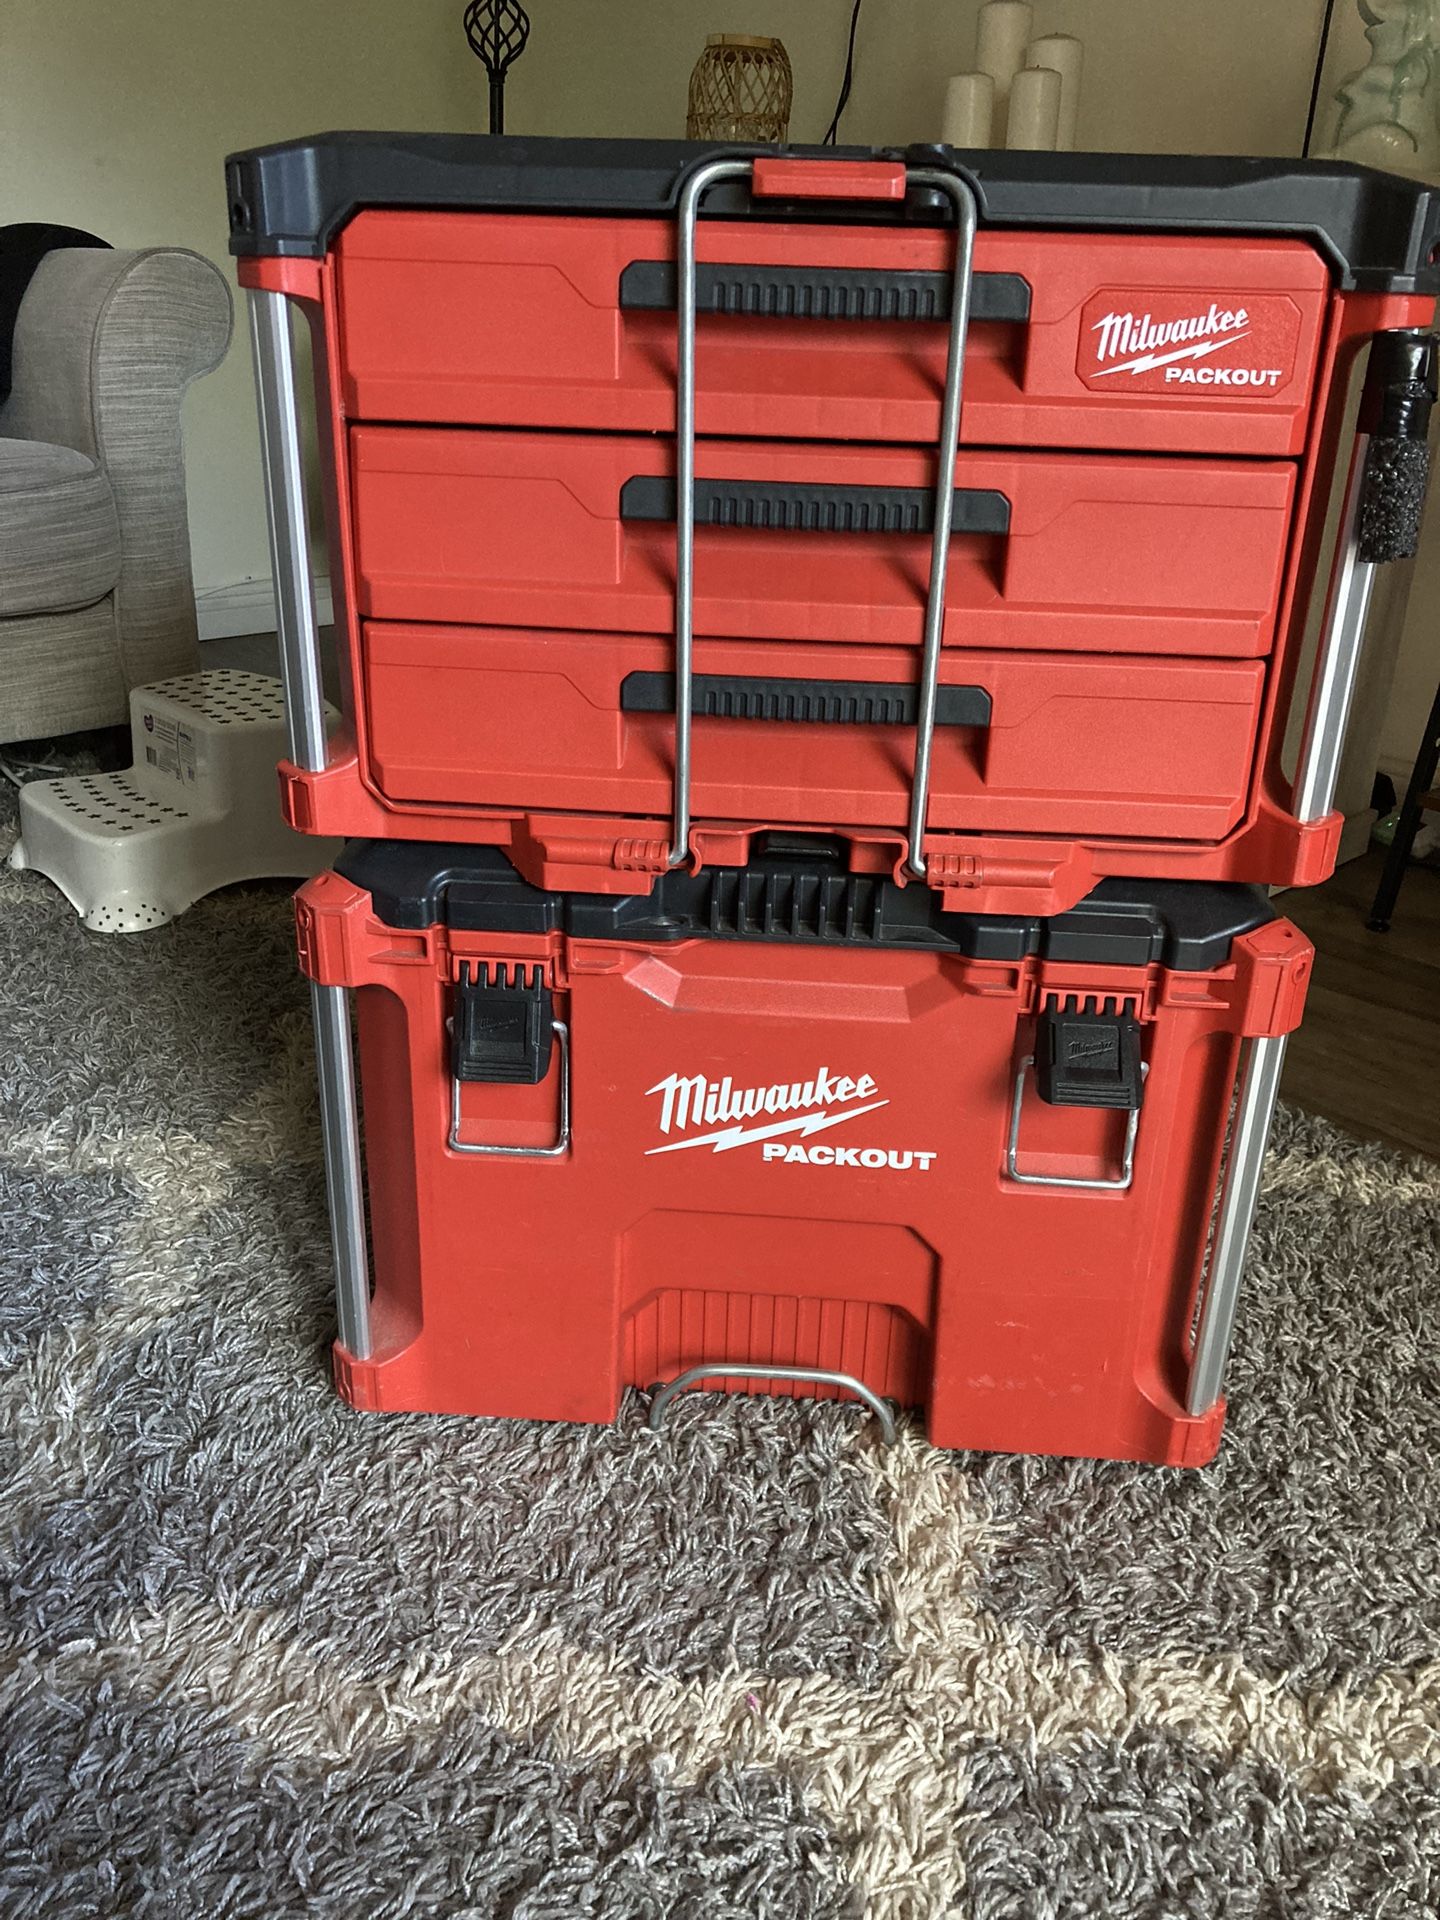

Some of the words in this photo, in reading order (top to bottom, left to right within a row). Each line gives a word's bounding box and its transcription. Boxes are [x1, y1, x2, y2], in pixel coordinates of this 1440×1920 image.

[1091, 304, 1250, 361] Milwaukee
[1164, 367, 1282, 387] PACKOUT
[644, 1066, 879, 1135] Milwaukee
[763, 1142, 938, 1172] PACKOUT
